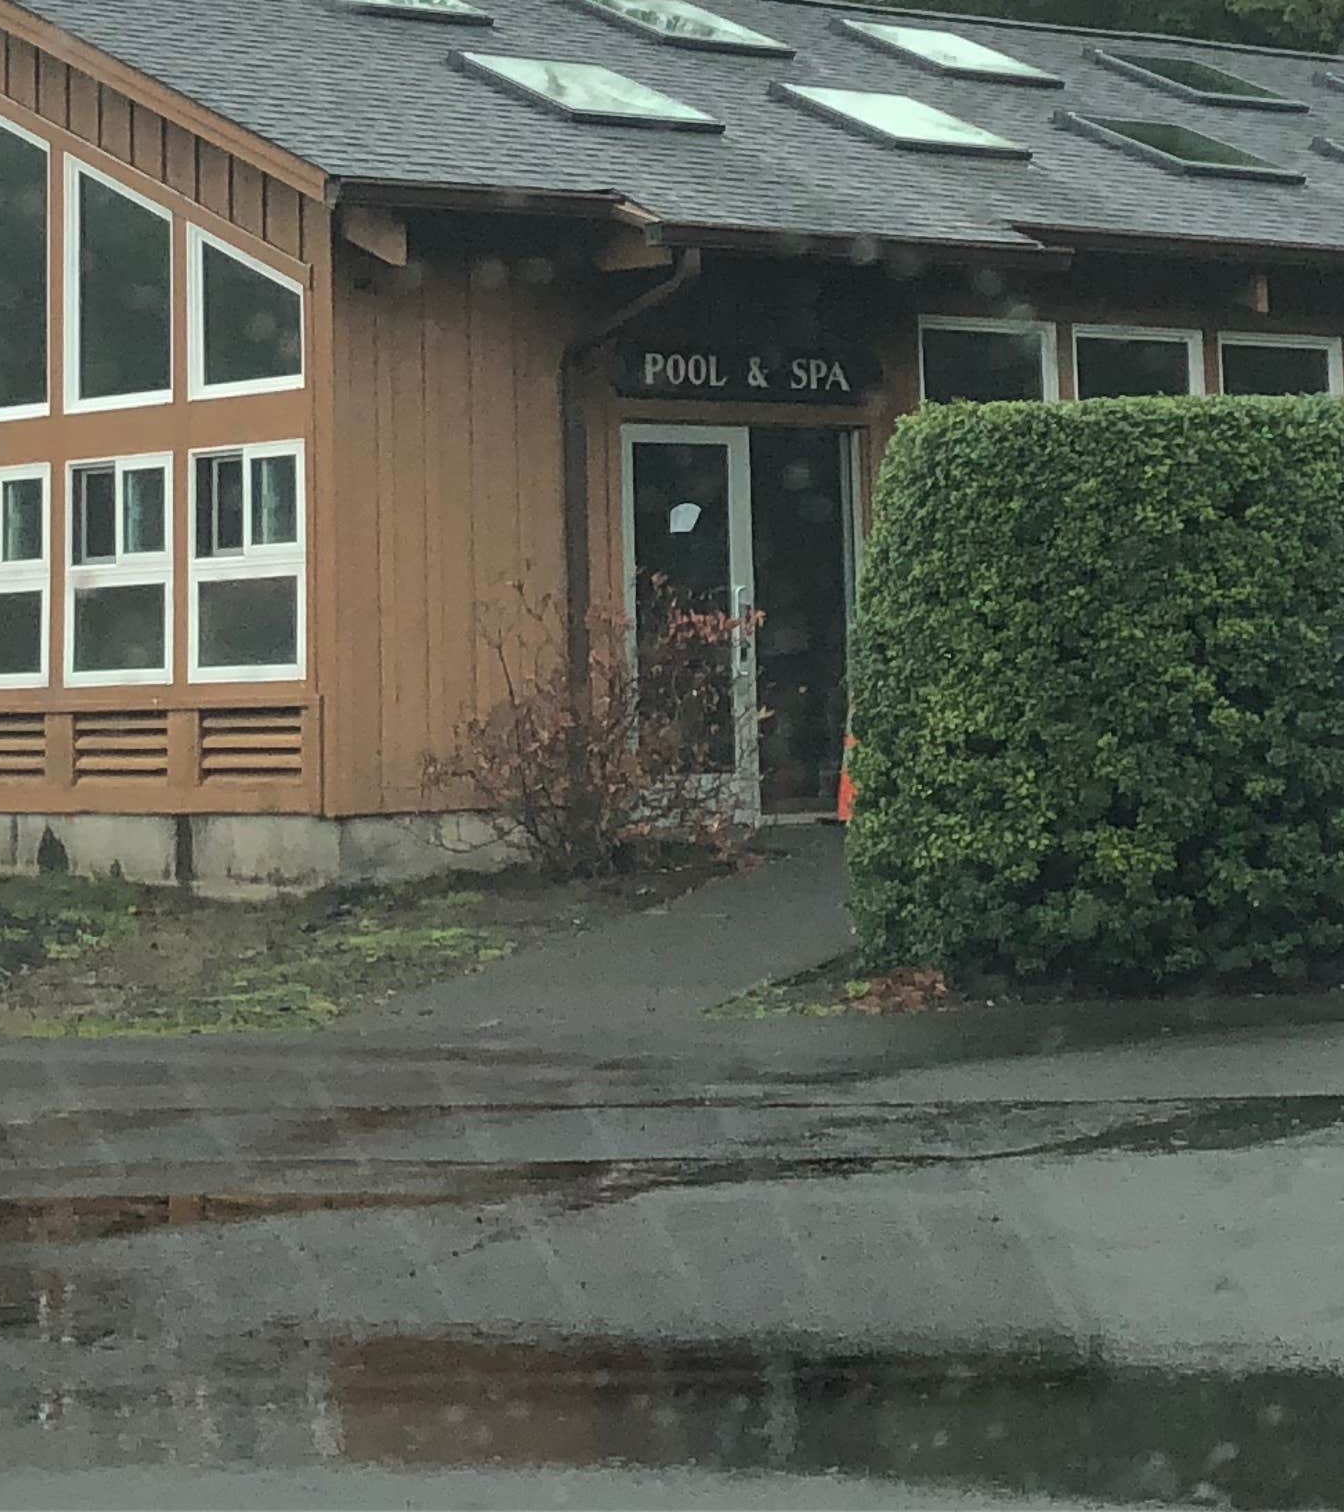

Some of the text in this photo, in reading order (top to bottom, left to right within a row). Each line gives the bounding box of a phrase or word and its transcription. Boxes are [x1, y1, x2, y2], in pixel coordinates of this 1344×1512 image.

[643, 352, 851, 392] POOL & SPA
